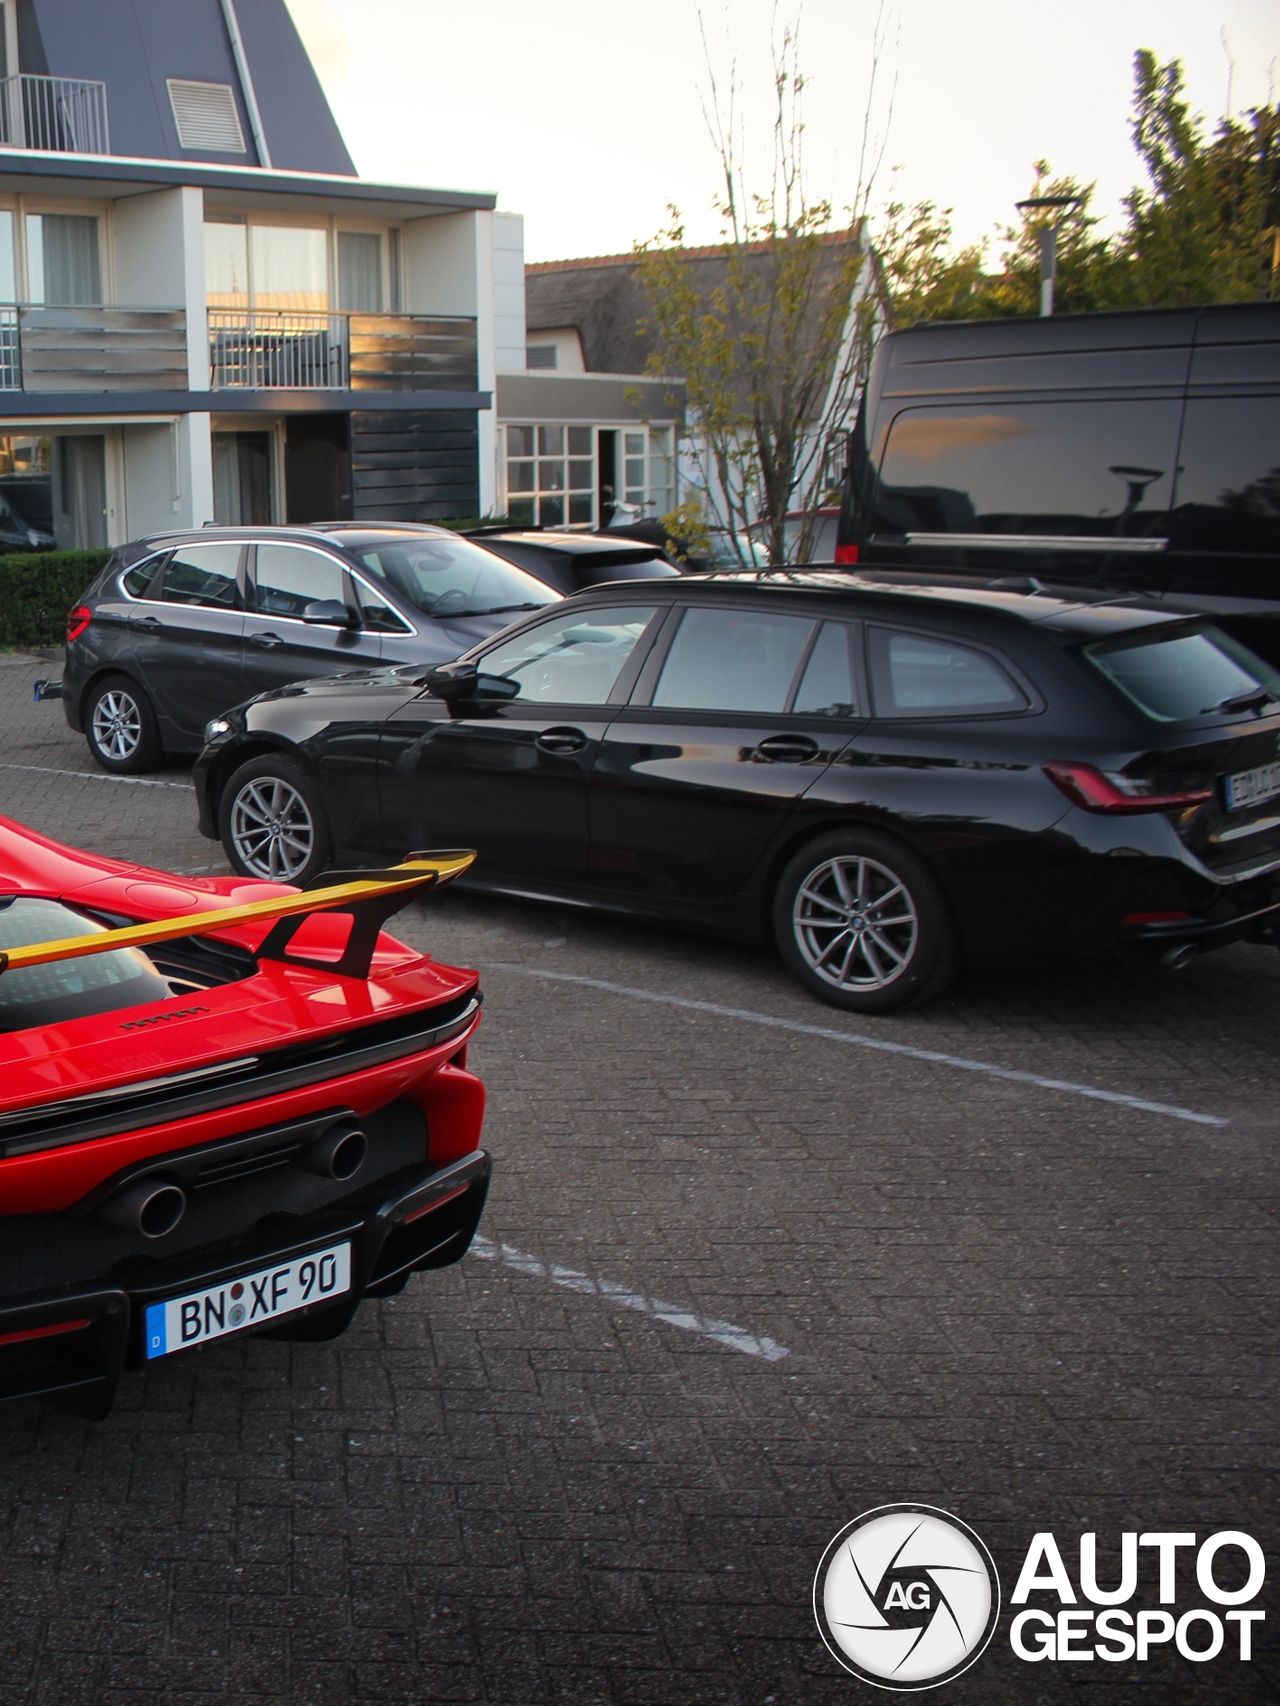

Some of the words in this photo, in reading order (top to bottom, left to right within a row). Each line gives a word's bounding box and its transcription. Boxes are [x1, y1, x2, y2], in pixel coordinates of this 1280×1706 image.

[180, 1290, 225, 1343] BN
[249, 1268, 291, 1319] XF
[299, 1253, 337, 1300] 90
[152, 1336, 161, 1349] D
